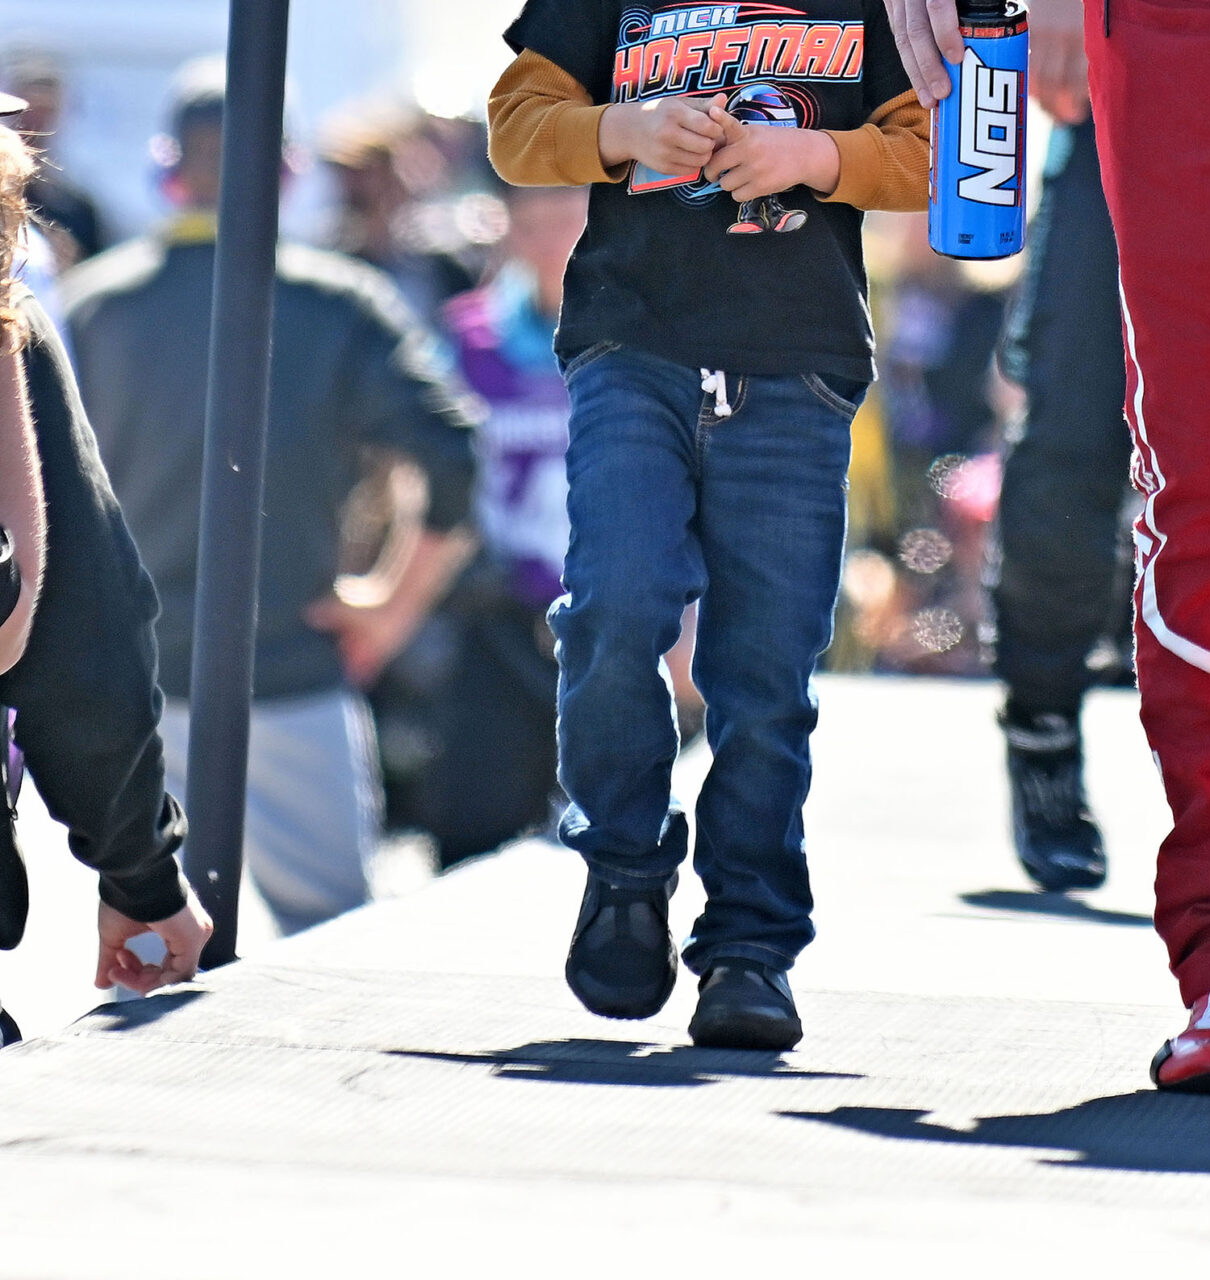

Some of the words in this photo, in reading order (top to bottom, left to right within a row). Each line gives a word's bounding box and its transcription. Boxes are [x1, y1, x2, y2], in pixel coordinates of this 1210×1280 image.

[652, 5, 739, 36] NICK
[613, 22, 864, 103] HOFFMAN
[957, 45, 1019, 208] NOS
